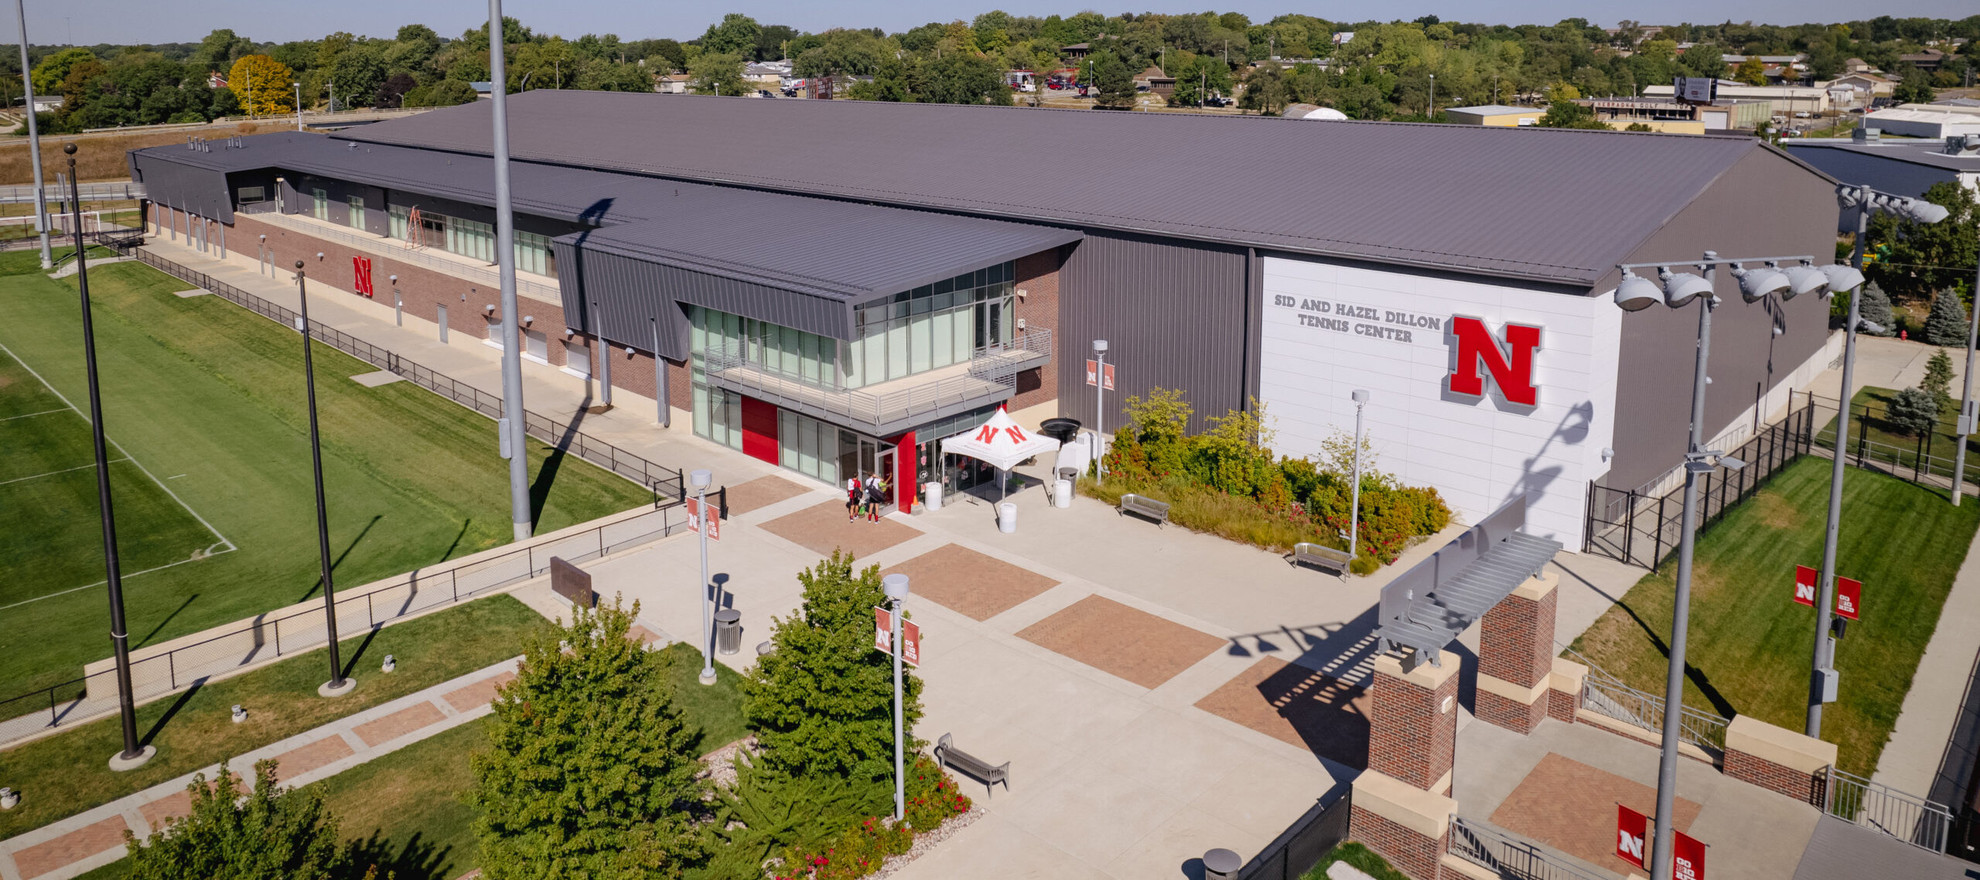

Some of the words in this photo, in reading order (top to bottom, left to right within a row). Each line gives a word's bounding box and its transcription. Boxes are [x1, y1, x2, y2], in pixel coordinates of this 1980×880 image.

[353, 256, 373, 296] N
[1274, 294, 1296, 308] SID
[1300, 298, 1331, 313] AND
[1335, 303, 1380, 321] HAZEL
[1385, 310, 1441, 330] DILLON
[1298, 313, 1350, 333] TENNIS
[1354, 323, 1413, 343] CENTER
[1449, 314, 1545, 408] N
[1088, 371, 1097, 382] N
[975, 424, 1000, 445] N
[1005, 425, 1027, 445] N
[688, 512, 698, 529] N
[1796, 582, 1815, 602] N
[876, 627, 890, 647] N
[1619, 829, 1644, 861] N
[1676, 857, 1692, 869] GO
